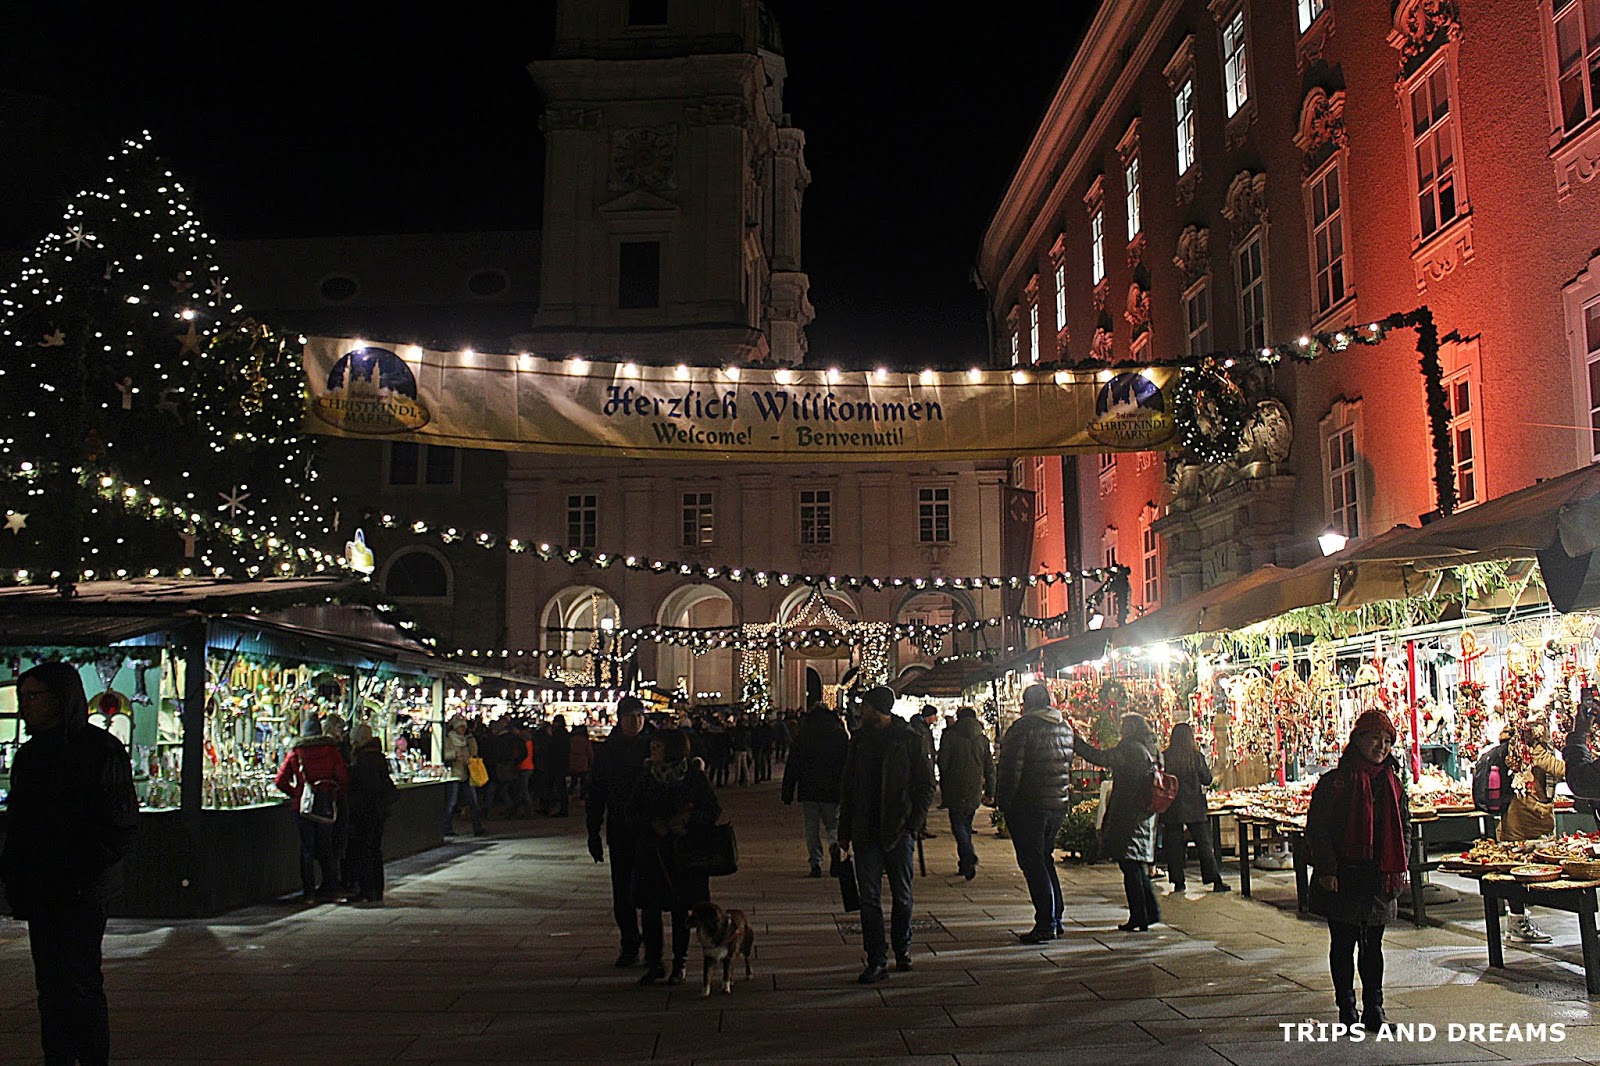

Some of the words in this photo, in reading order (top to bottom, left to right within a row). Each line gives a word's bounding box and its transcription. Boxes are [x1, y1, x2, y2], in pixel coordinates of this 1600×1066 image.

[603, 385, 738, 420] Herzlich
[752, 390, 943, 422] Willkommen
[343, 411, 395, 424] MARKT
[652, 422, 752, 446] Welcome!
[796, 425, 904, 447] Benvenuti!
[1115, 430, 1152, 440] MARKT
